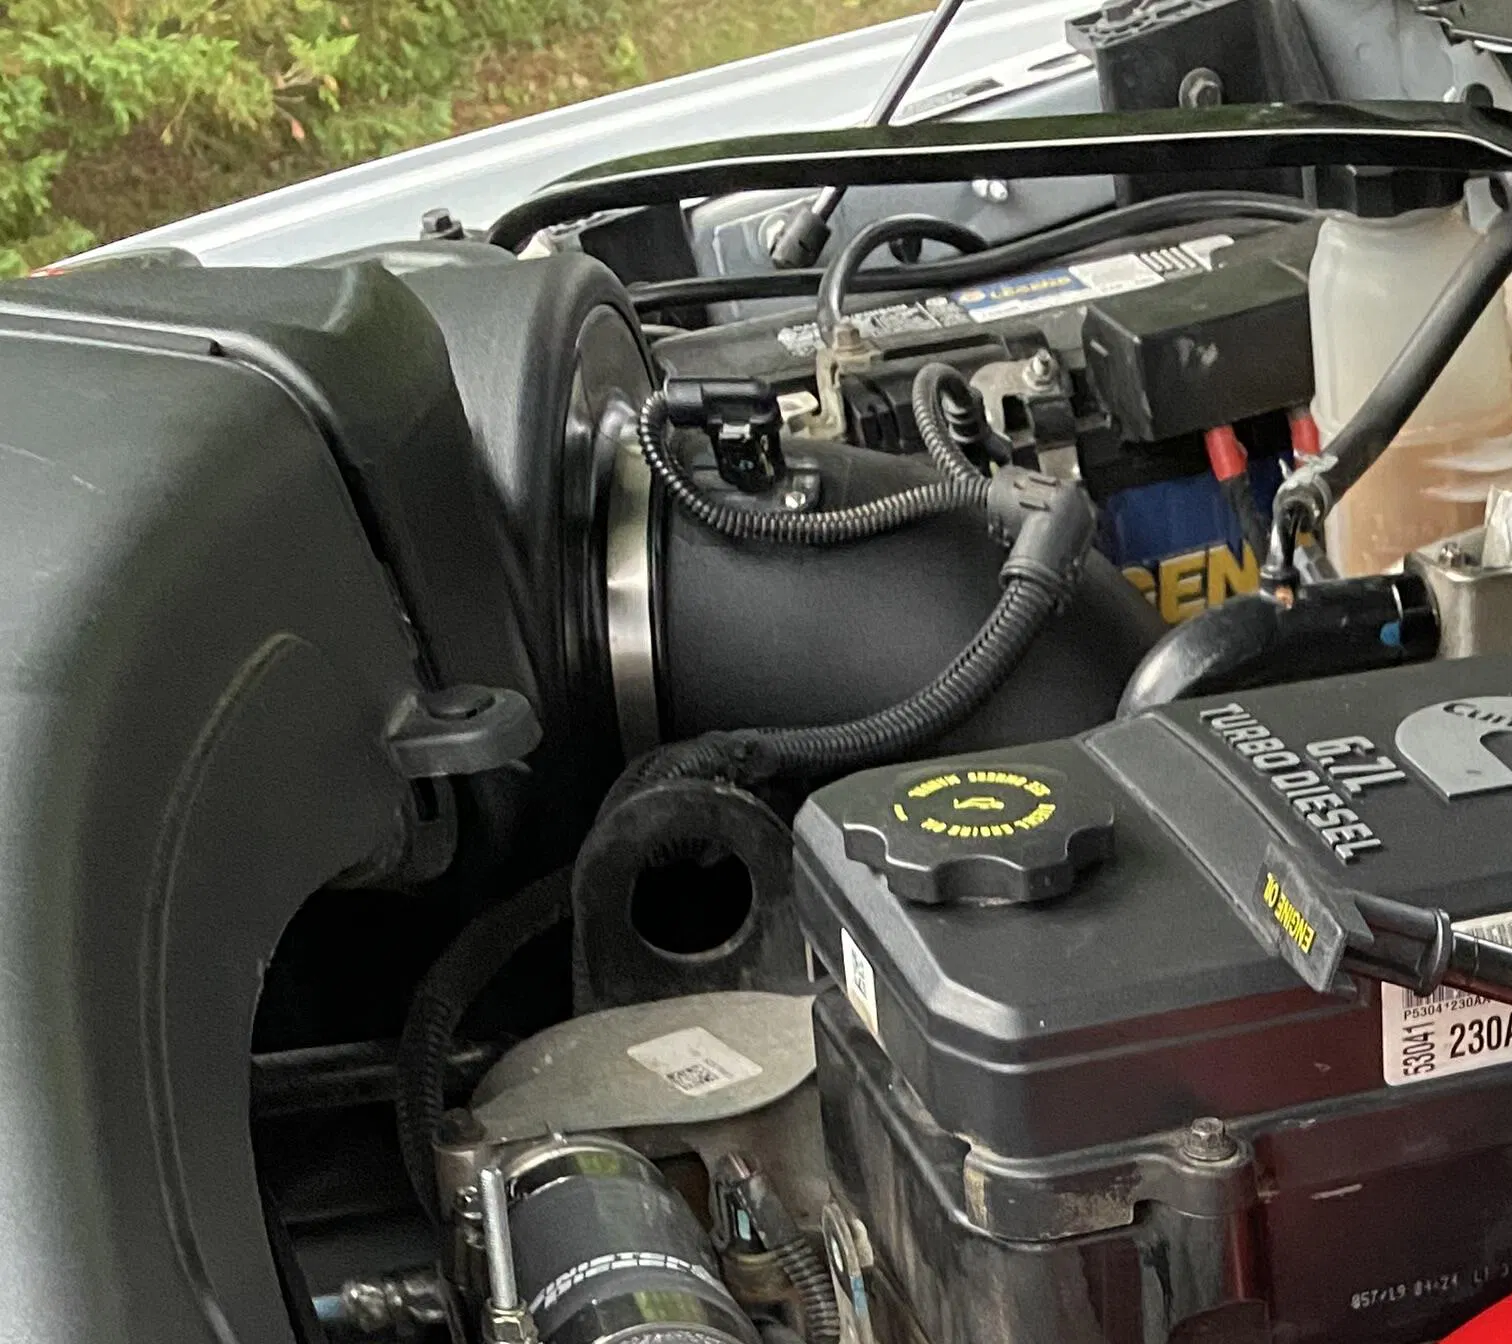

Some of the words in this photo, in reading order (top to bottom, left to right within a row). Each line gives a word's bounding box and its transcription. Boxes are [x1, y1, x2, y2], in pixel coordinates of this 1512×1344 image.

[1199, 702, 1301, 778] TURBO
[1270, 759, 1384, 866] DIESEL
[1306, 735, 1407, 799] 6.7L
[1263, 873, 1280, 908] OIL
[1274, 892, 1316, 954] ENGINE
[1402, 1021, 1436, 1077] 53041
